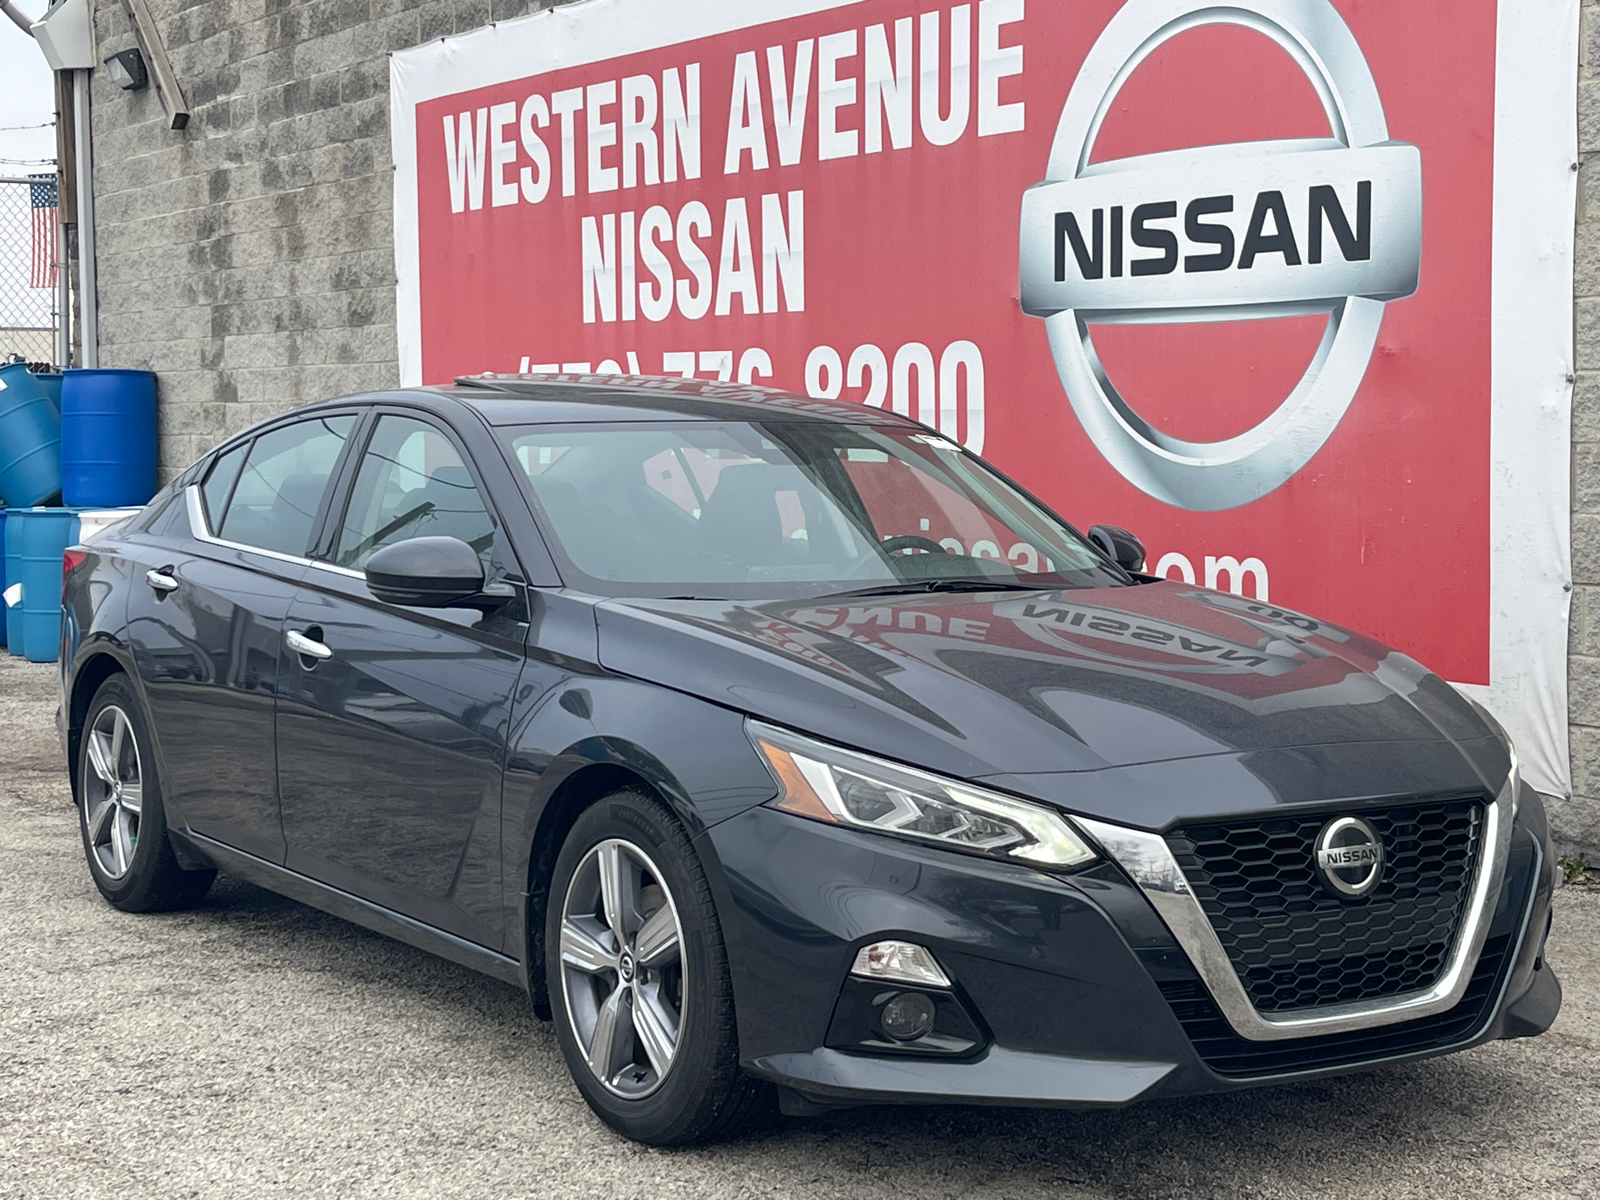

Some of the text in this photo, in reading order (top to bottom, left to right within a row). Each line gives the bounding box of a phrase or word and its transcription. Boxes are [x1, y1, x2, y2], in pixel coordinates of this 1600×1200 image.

[443, 0, 1025, 214] WESTERN AVENUE
[581, 190, 805, 323] NISSAN
[1054, 180, 1372, 282] NISSAN
[1141, 552, 1269, 603] om
[1326, 848, 1378, 864] NISSAN
